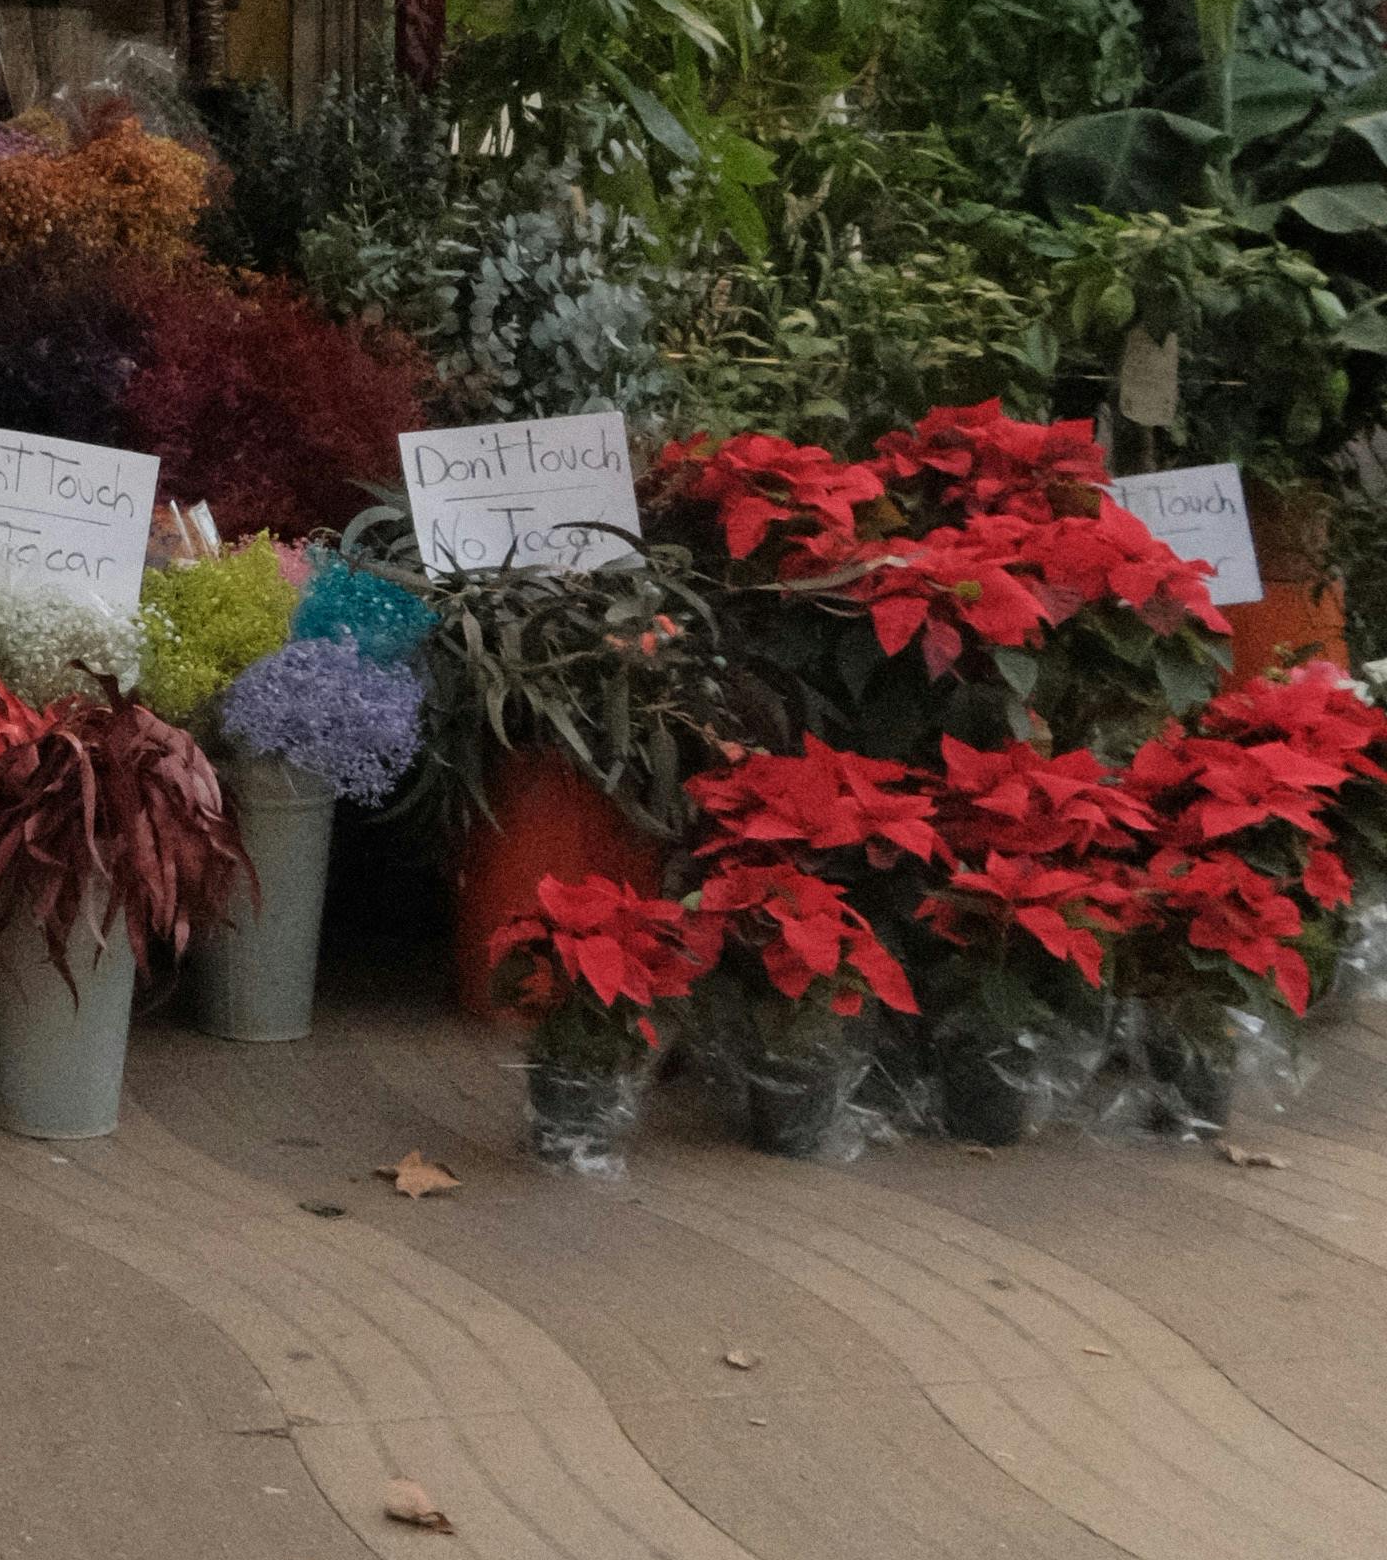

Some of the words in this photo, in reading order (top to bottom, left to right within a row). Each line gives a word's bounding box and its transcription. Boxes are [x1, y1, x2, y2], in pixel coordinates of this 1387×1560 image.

[39, 450, 135, 518] Touch
[1145, 481, 1237, 517] Touch
[432, 511, 487, 563] No
